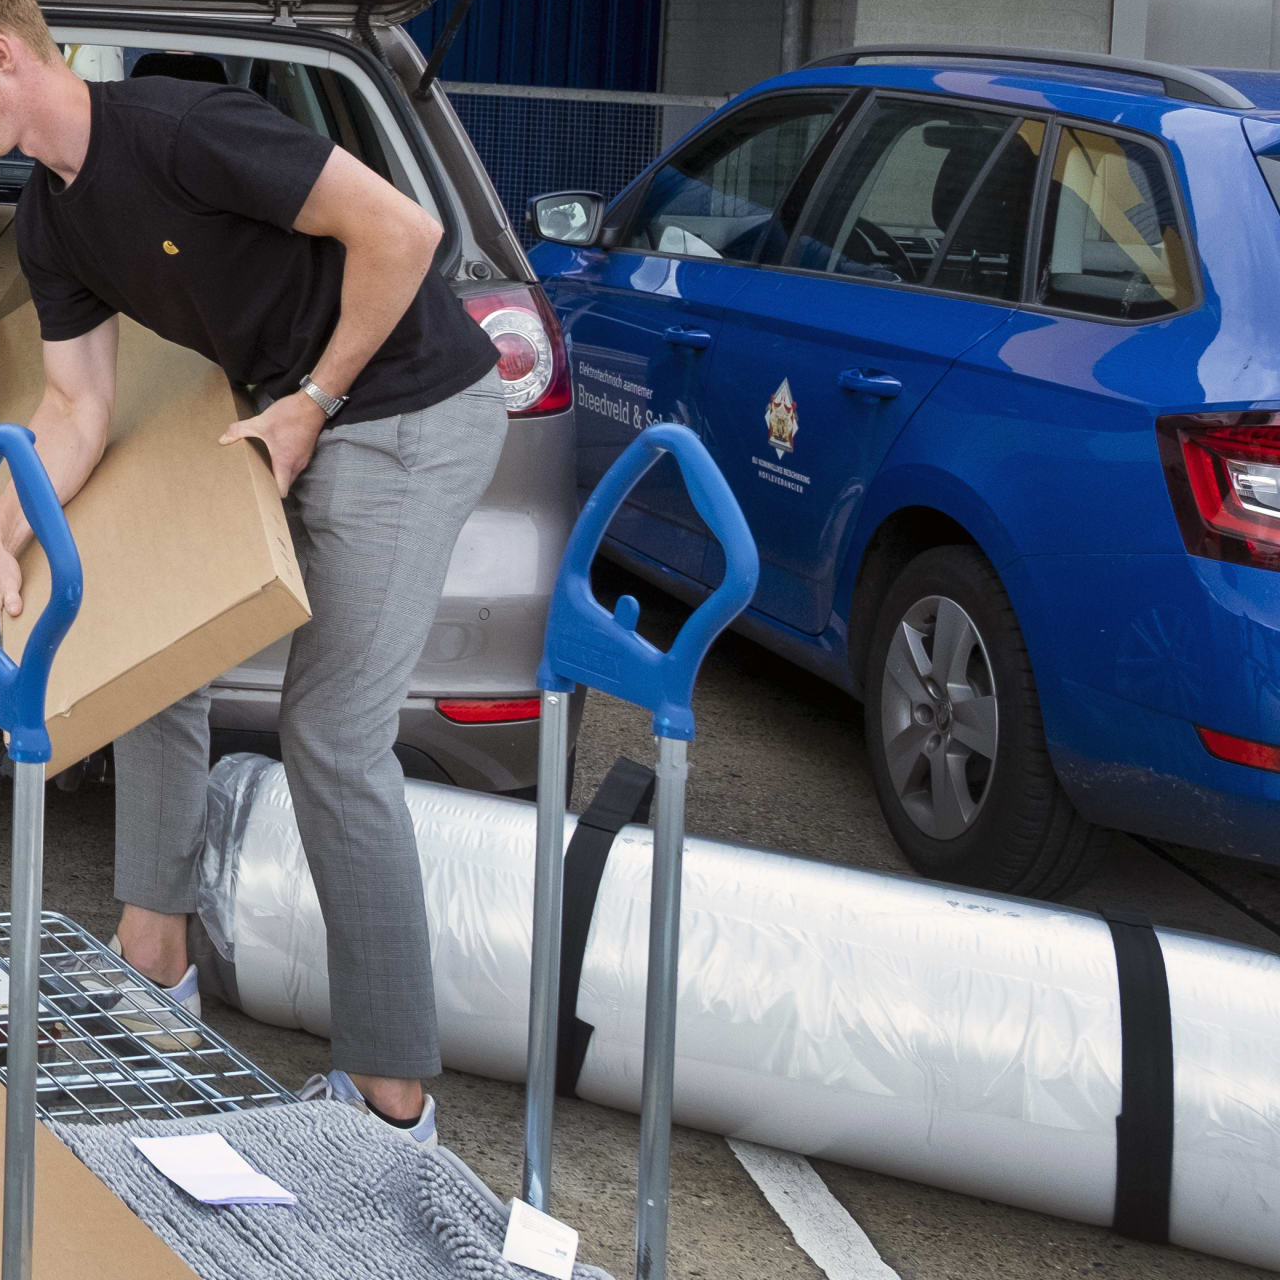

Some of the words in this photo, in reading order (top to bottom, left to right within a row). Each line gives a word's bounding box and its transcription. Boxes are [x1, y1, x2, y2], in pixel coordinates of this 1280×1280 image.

[578, 361, 623, 388] Elektrotechnisch
[623, 380, 654, 400] aannemer
[578, 384, 630, 424] Breedveld
[633, 405, 642, 430] &
